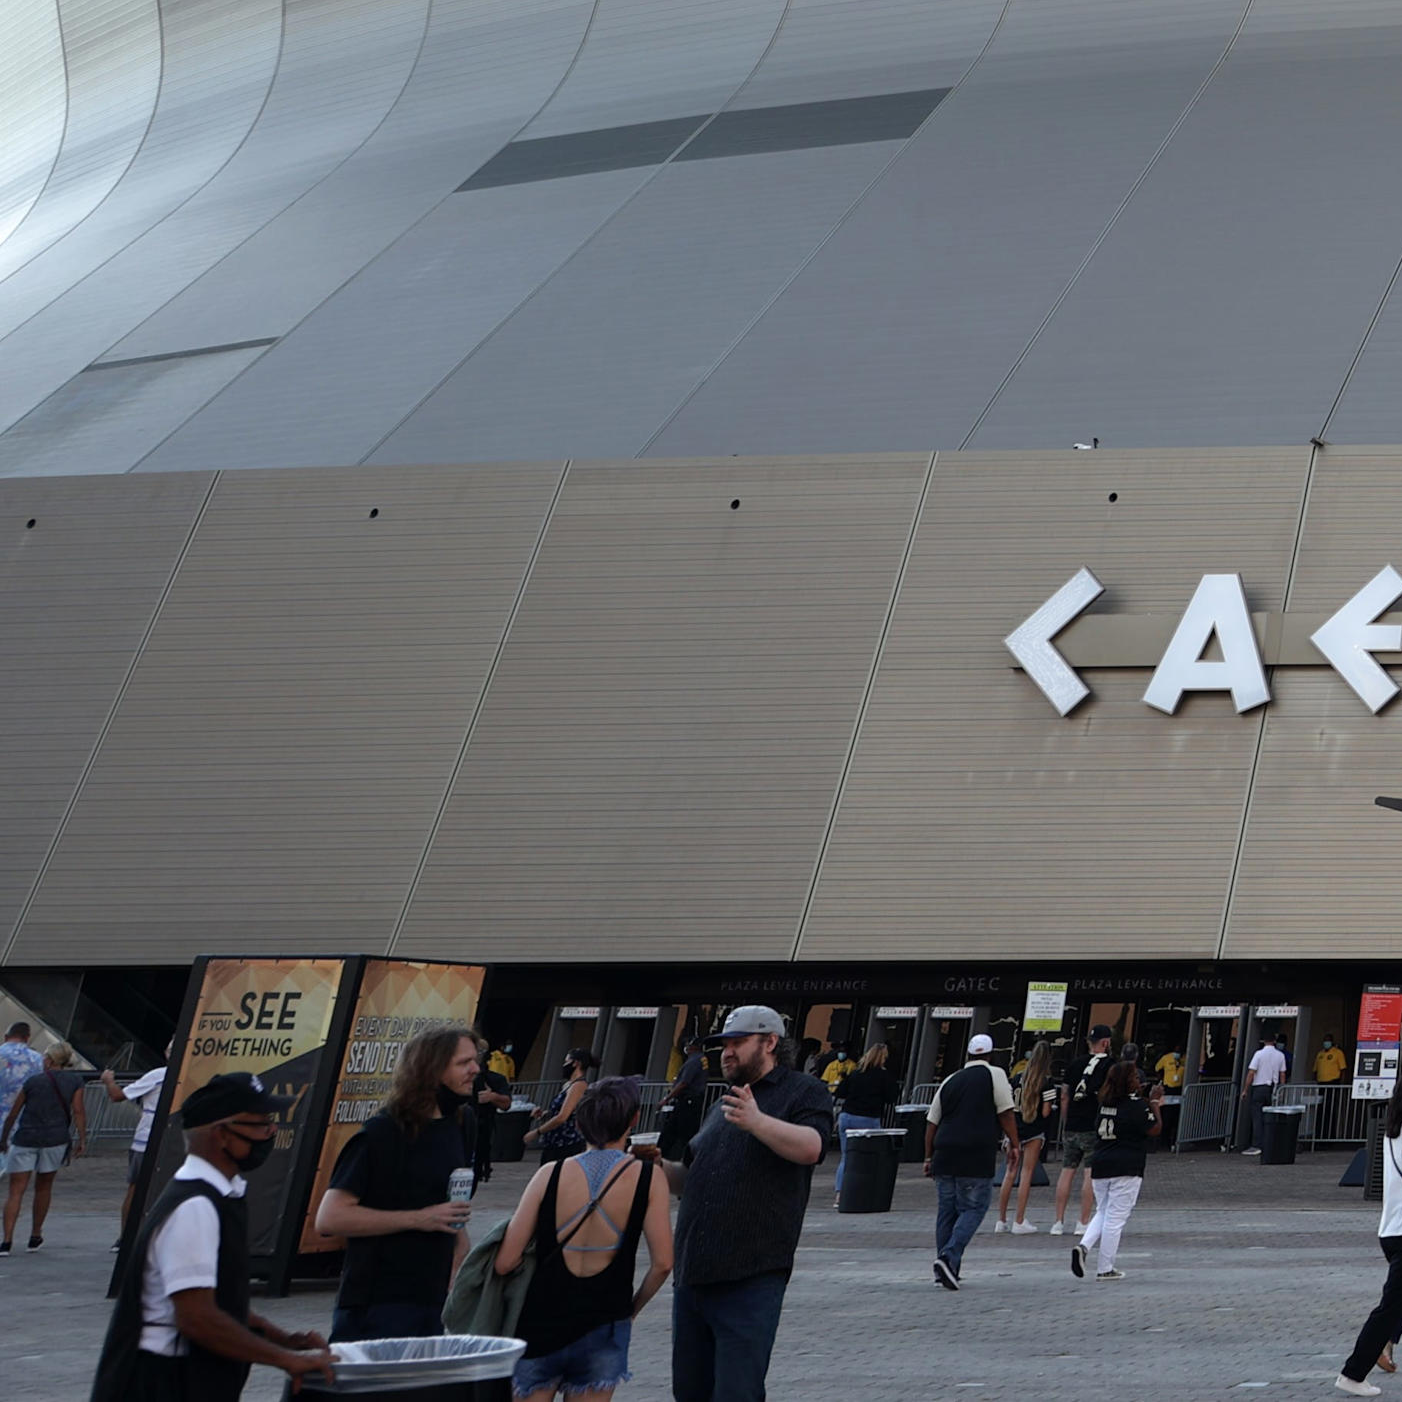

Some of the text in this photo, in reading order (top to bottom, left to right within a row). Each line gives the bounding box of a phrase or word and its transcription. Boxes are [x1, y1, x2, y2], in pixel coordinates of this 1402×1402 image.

[720, 981, 869, 991] PLAZA LEVEL ENTRANCE
[944, 977, 1001, 992] GATE C
[1074, 979, 1224, 990] PLAZA LEVEL ENTRANCE
[198, 991, 302, 1030] IF YOU SEE
[354, 1017, 392, 1037] EVENT
[390, 1018, 413, 1038] DAY
[192, 1038, 293, 1057] SOMETHING
[346, 1040, 381, 1074] SEND
[1098, 1117, 1118, 1140] 41
